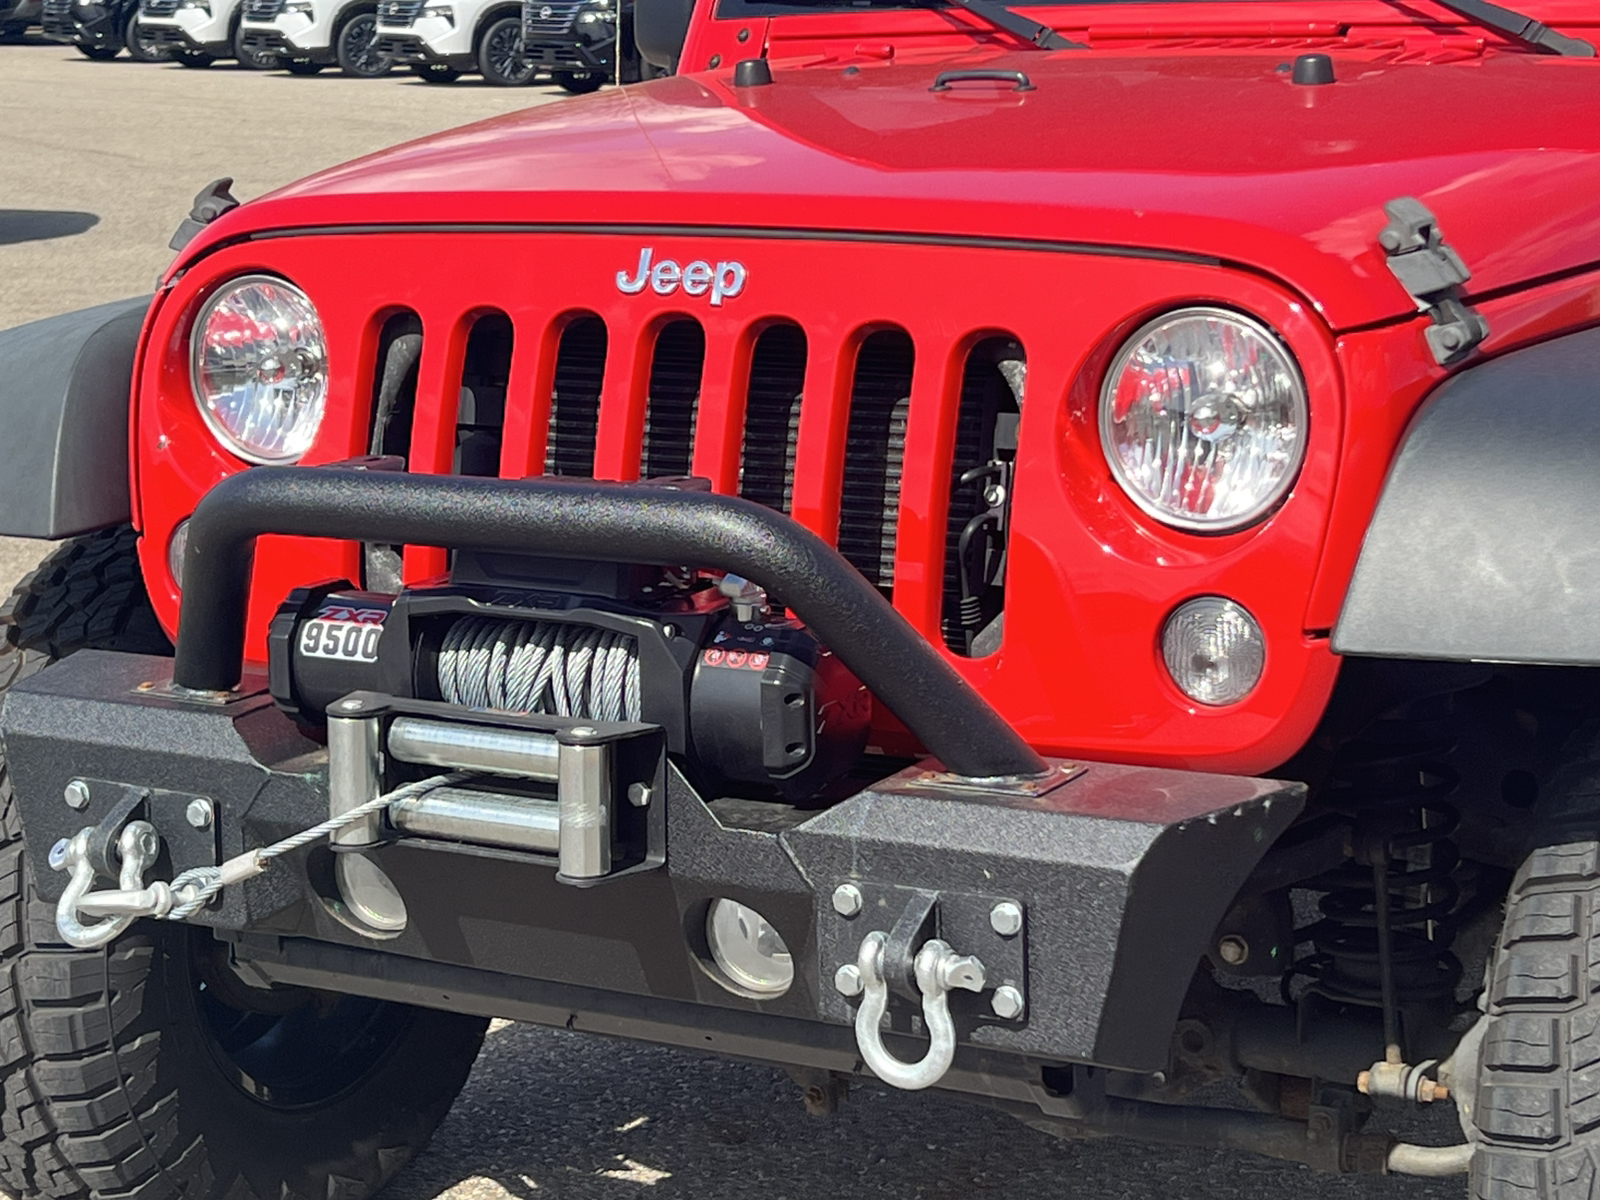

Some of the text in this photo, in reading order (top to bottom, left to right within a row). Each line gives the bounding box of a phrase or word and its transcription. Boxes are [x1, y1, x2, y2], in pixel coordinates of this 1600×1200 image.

[616, 247, 747, 306] Jeep
[319, 605, 388, 625] ZXR
[302, 621, 382, 660] 9500
